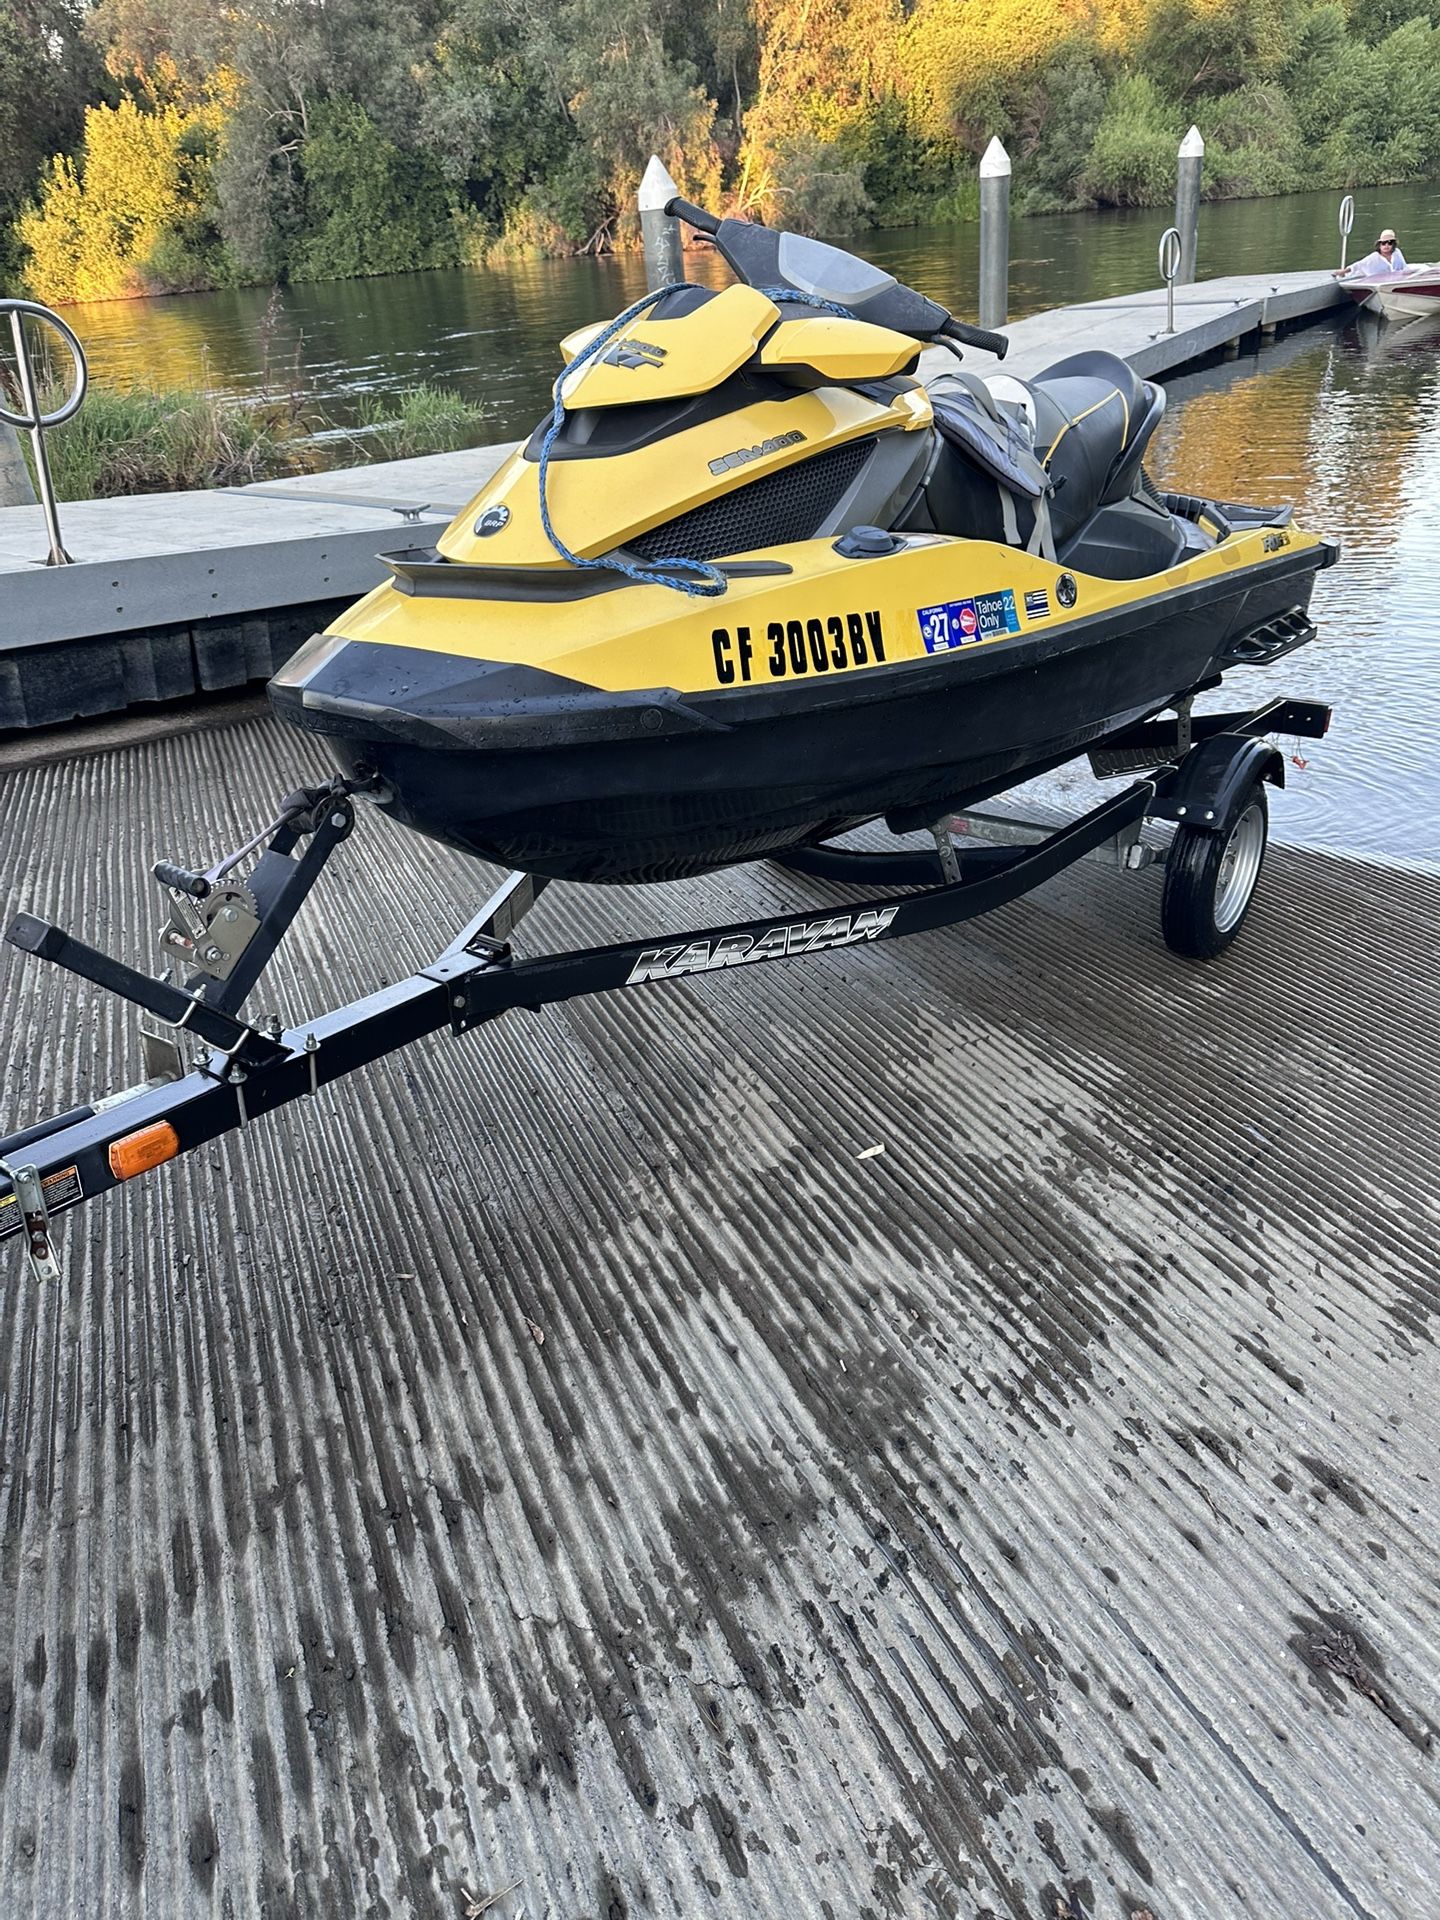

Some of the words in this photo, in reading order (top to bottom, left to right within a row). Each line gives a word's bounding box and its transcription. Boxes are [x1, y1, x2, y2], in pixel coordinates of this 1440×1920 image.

[484, 520, 504, 528] BRP
[976, 600, 1003, 614] Tahoe
[1003, 596, 1015, 611] 22
[930, 613, 949, 643] 27
[979, 614, 1000, 629] Only
[711, 626, 752, 684] CF
[767, 610, 886, 677] 3003BV
[625, 906, 900, 985] KARAVAN
